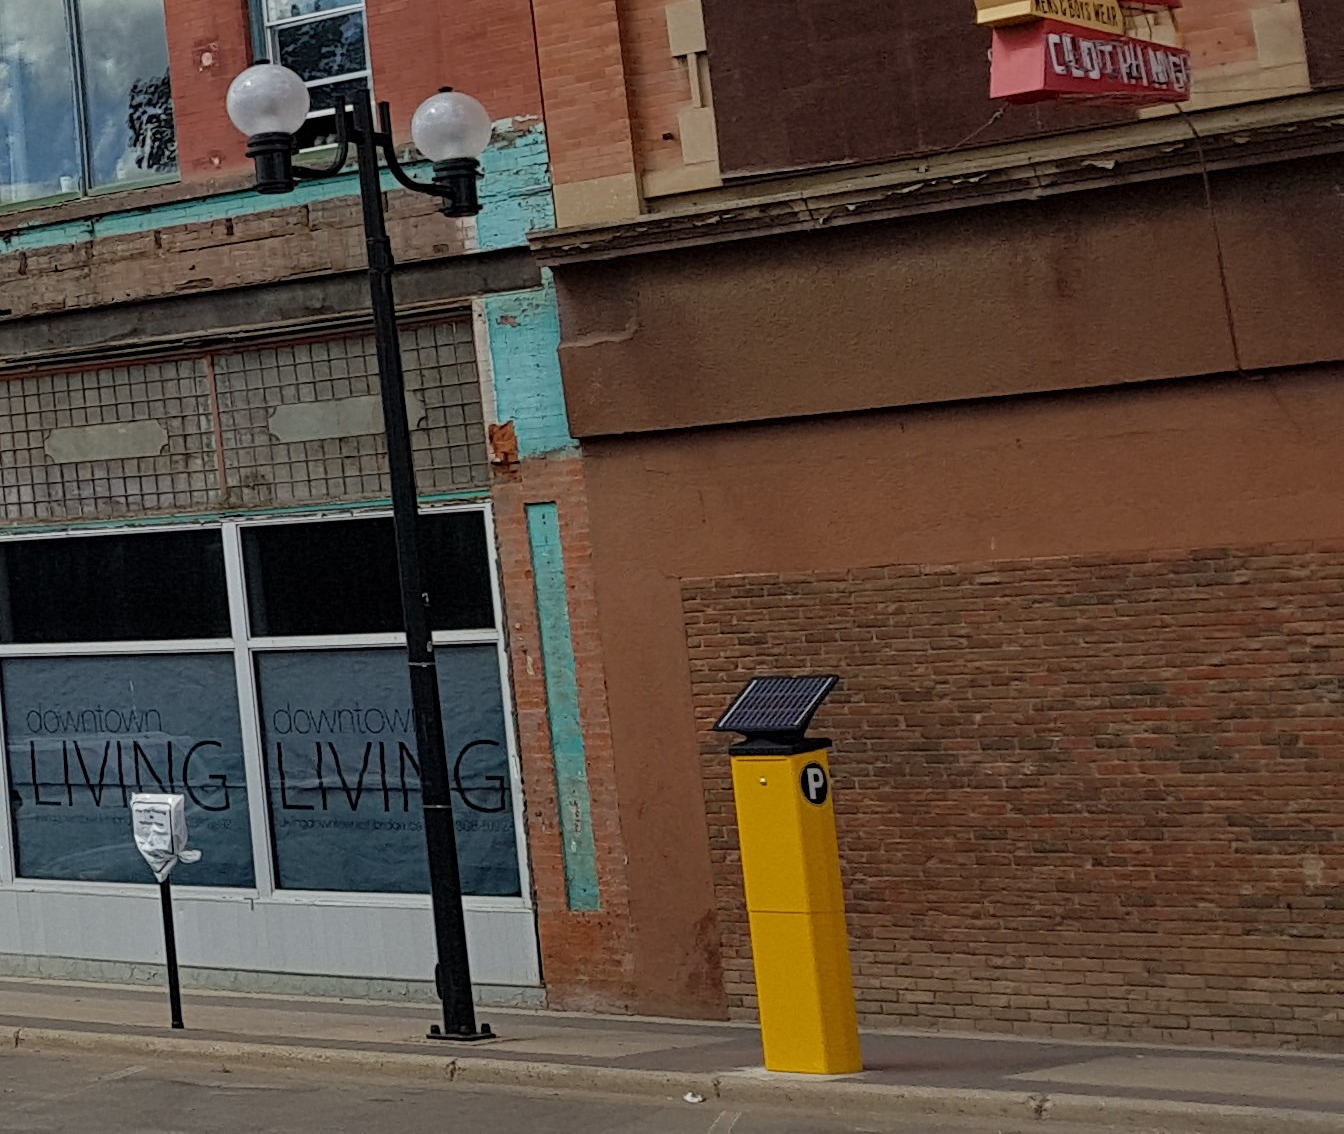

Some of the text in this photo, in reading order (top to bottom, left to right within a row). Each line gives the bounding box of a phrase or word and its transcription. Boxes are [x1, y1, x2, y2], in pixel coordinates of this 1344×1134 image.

[1092, 2, 1119, 28] WEAR
[1048, 32, 1191, 94] CLOTHING
[26, 702, 163, 734] downtown
[272, 703, 418, 735] downtow
[29, 739, 231, 812] LIVING
[276, 739, 507, 813] LIVING
[806, 767, 825, 800] P
